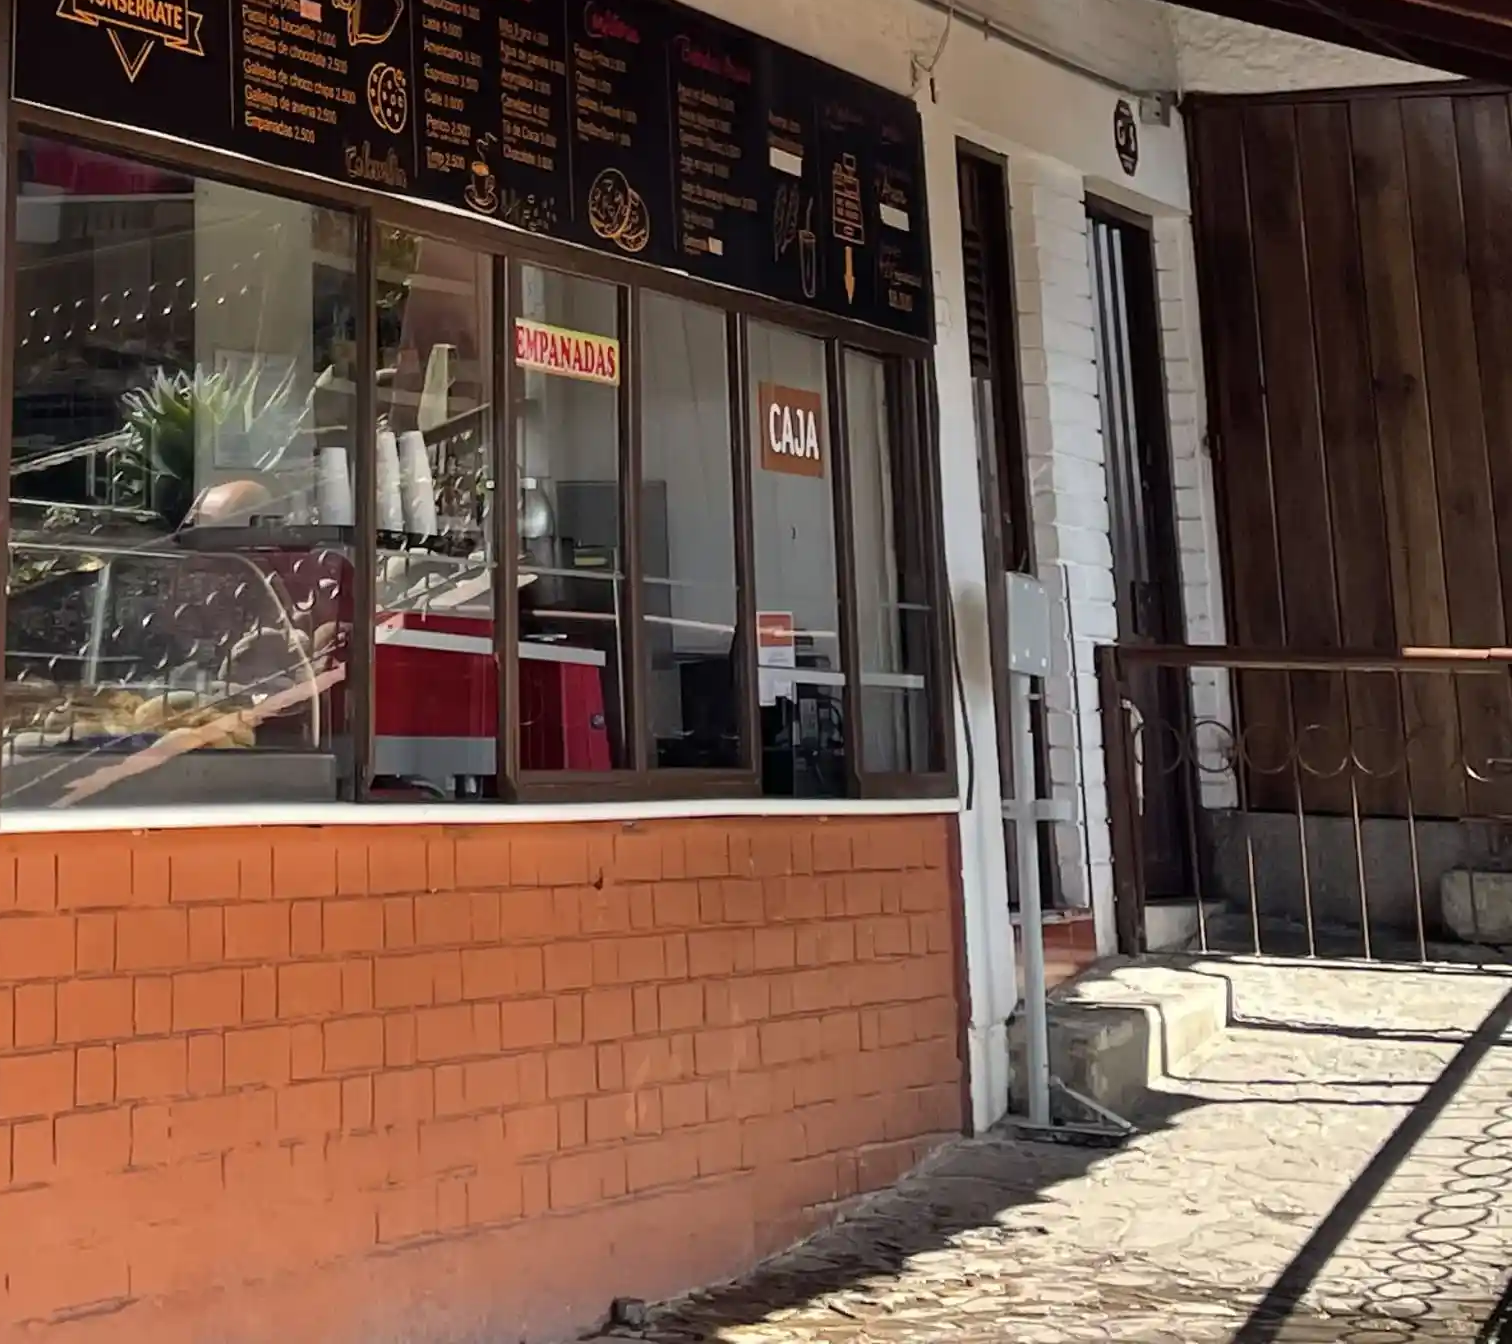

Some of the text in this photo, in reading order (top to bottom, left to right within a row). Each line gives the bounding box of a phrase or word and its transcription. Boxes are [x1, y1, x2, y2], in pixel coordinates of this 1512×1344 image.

[245, 111, 293, 138] Empanadas
[515, 326, 615, 378] EMPANADAS
[769, 403, 820, 460] CAJA
